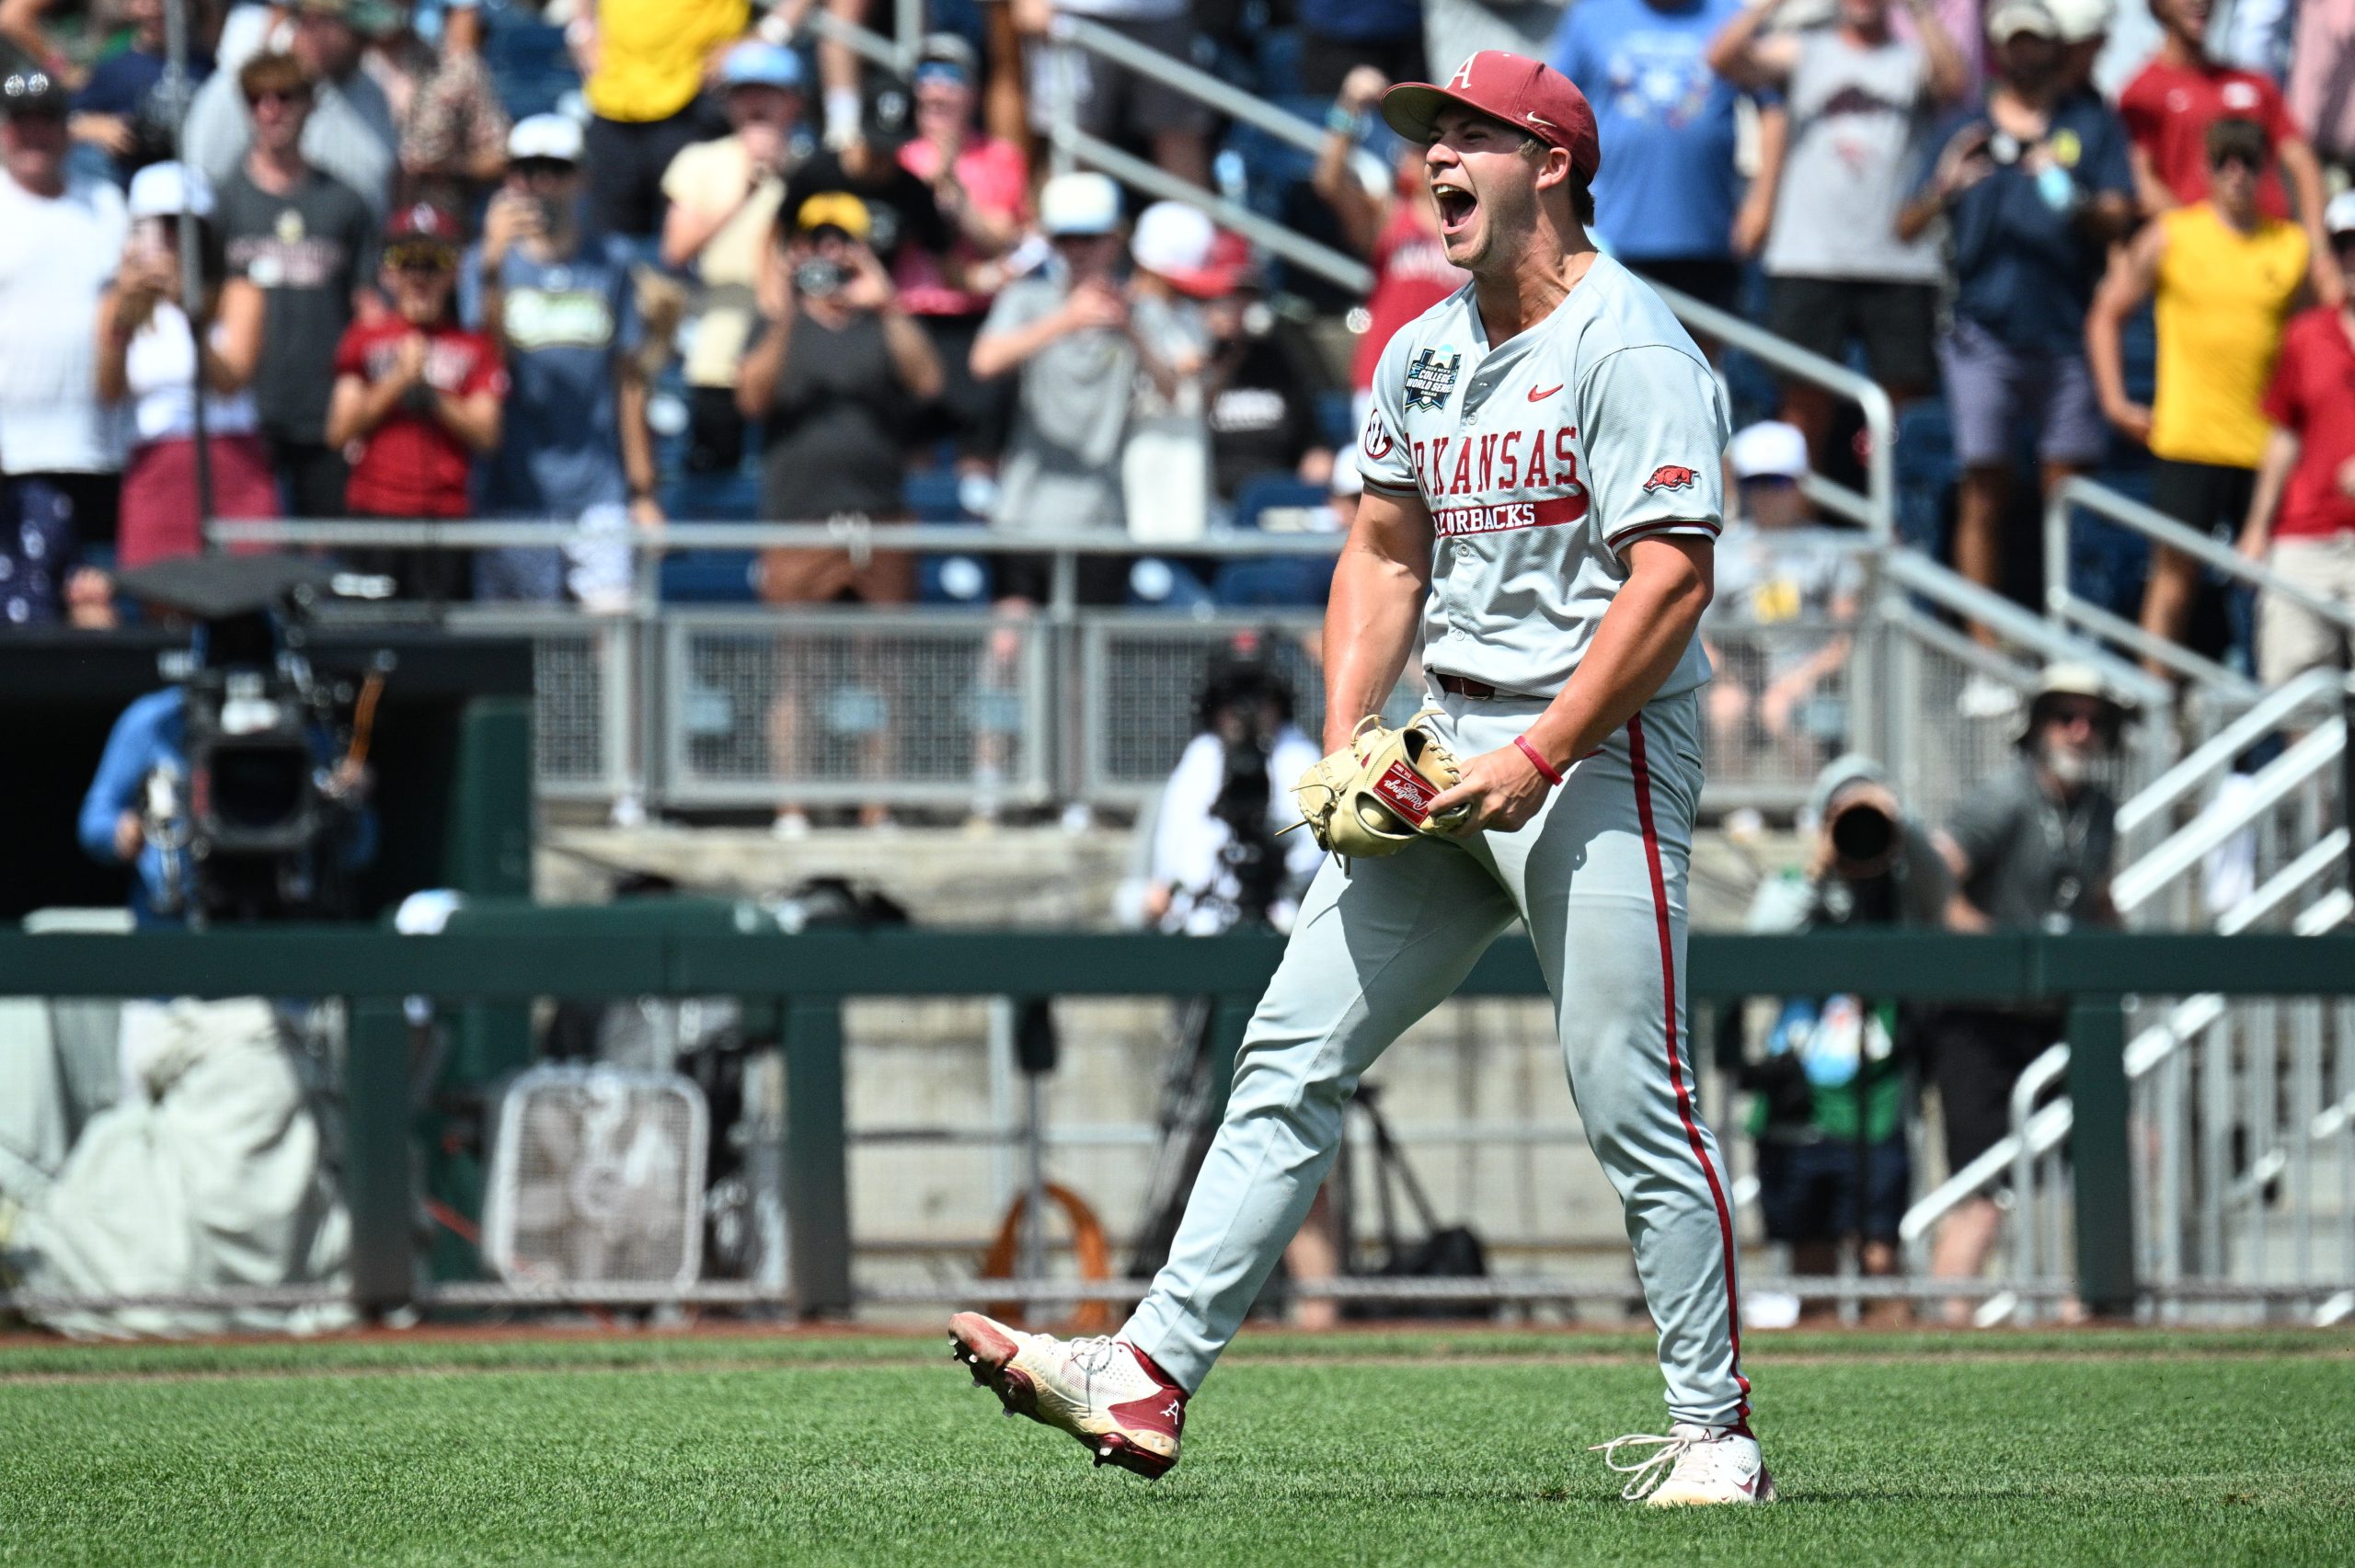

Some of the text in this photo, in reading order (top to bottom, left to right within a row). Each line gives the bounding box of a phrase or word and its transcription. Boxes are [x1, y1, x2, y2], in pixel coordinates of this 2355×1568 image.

[1443, 52, 1478, 90] A
[1406, 378, 1432, 390] WORLD
[1418, 369, 1451, 383] COLLEGE
[1432, 503, 1535, 536] ZORBACKS
[1384, 780, 1429, 810] Rawlings
[1159, 1399, 1179, 1425] A
